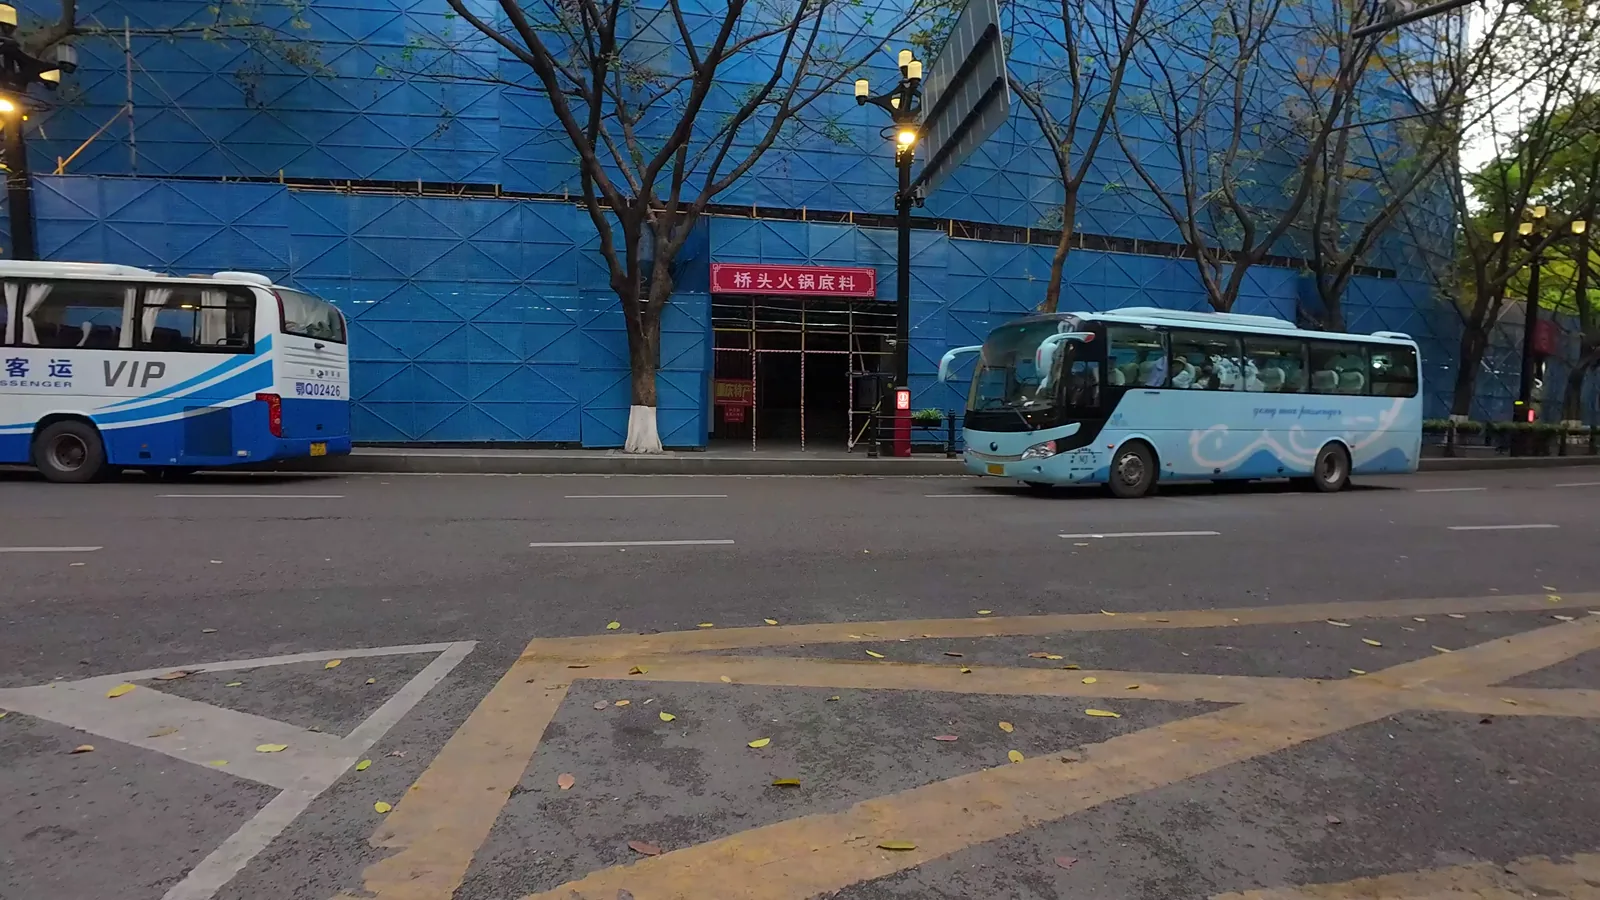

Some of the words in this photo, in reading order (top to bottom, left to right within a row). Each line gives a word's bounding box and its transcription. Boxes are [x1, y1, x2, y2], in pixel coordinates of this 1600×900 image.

[733, 271, 856, 291] 桥头火锅底料
[5, 356, 74, 379] 客运
[103, 360, 166, 388] VIP
[295, 381, 341, 397] 鄂Q02426
